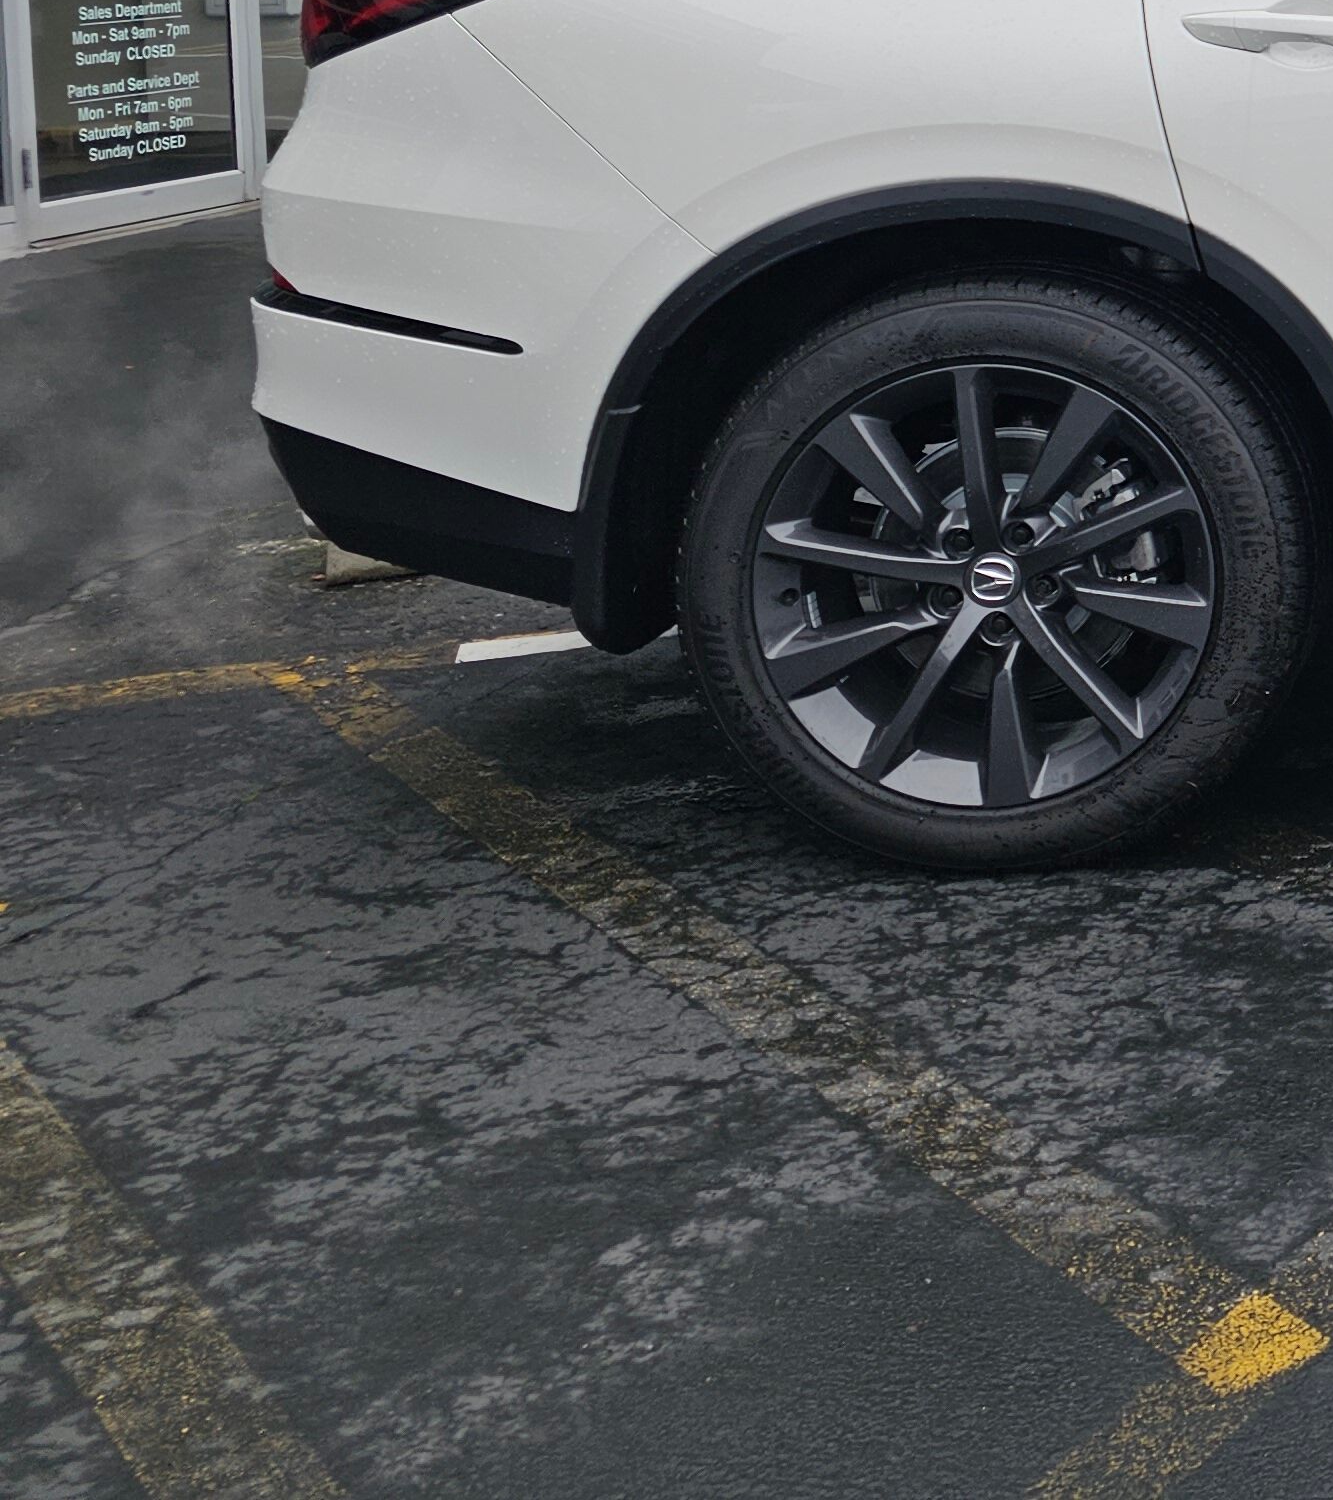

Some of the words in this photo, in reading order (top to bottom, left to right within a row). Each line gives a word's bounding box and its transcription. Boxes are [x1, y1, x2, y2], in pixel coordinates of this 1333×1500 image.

[78, 6, 113, 20] Sales
[115, 0, 182, 19] Department
[72, 30, 99, 45] Mon
[109, 27, 129, 41] Sat
[131, 26, 156, 40] 9am
[165, 23, 190, 39] 7pm
[75, 49, 121, 66] Sunday
[126, 43, 176, 60] CLOSED
[67, 84, 99, 98] Parts
[102, 79, 125, 95] and
[127, 75, 171, 92] Service
[173, 71, 200, 88] Dept
[78, 107, 104, 121] Mon
[115, 101, 132, 117] Fri
[134, 100, 158, 114] 7am
[167, 96, 193, 112] 6pm
[78, 123, 132, 143] Saturday
[135, 120, 160, 134] 8am
[169, 115, 194, 132] 5pm
[88, 143, 134, 162] Sunday
[136, 134, 187, 155] CLOSED
